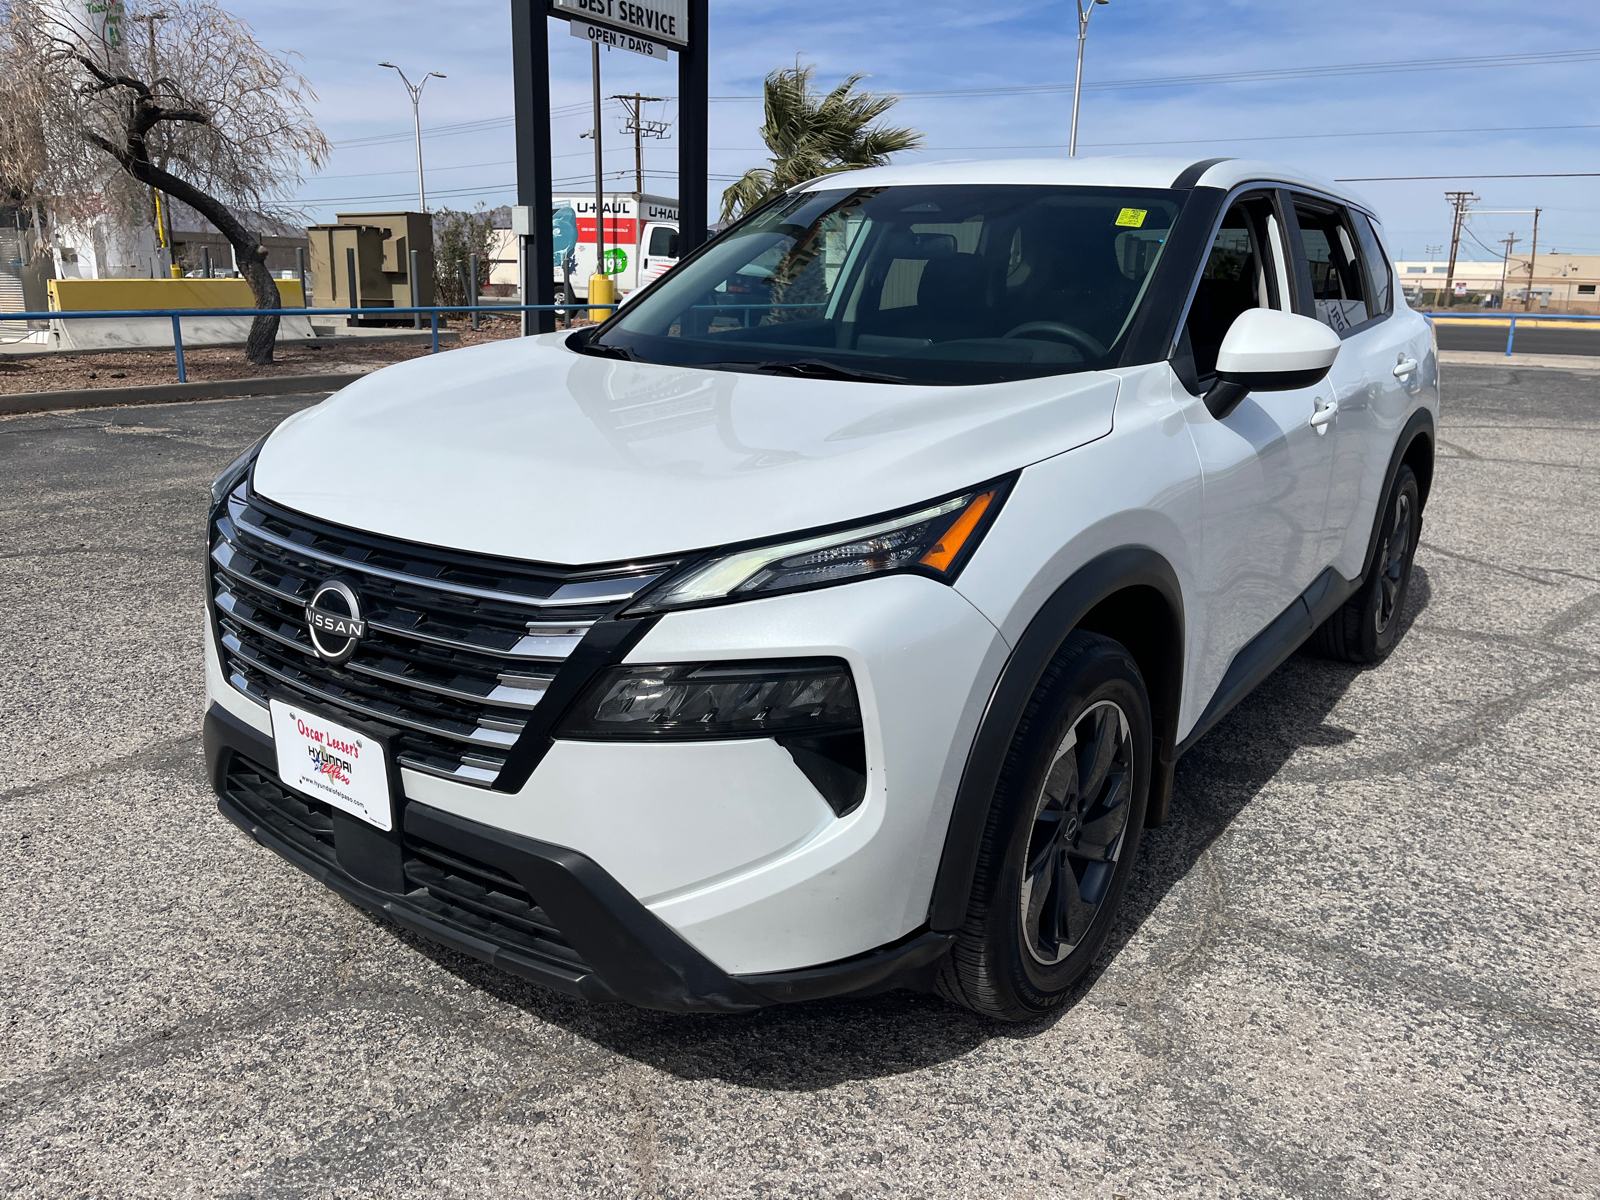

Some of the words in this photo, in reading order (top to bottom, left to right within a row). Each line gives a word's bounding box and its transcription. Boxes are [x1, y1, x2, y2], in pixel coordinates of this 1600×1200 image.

[619, 1, 676, 36] SERVICE
[588, 26, 617, 46] OPEN
[620, 35, 626, 48] 7
[629, 38, 654, 55] DAYS
[649, 206, 680, 221] U-HAU
[305, 607, 362, 636] NISSAN
[297, 718, 325, 744] Oscar
[326, 731, 359, 759] Leeser's
[308, 745, 352, 774] HYUNDAI
